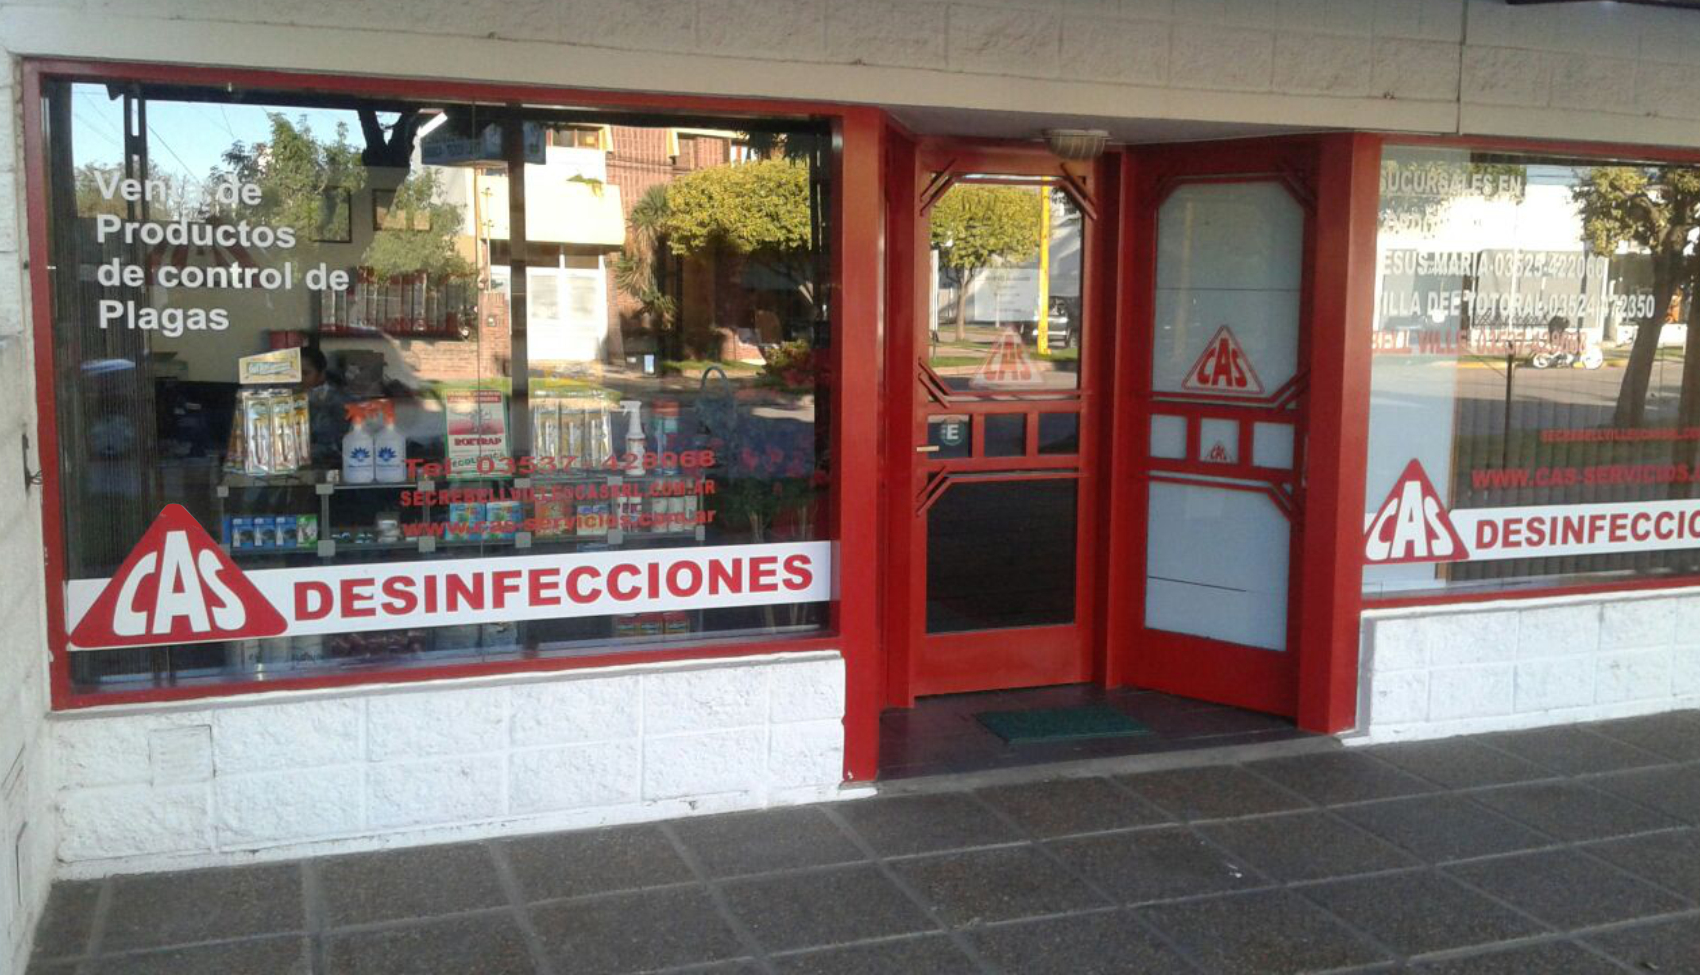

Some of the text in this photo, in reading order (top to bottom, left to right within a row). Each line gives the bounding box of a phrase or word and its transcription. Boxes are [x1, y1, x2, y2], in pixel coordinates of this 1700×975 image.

[94, 170, 262, 205] Ven de
[1498, 174, 1521, 197] EN
[97, 215, 296, 248] Productos
[98, 258, 145, 288] de
[157, 262, 292, 290] control
[305, 264, 349, 291] de
[99, 300, 230, 337] Plagas
[985, 334, 1032, 381] CAS
[1197, 337, 1247, 388] CAS
[1365, 480, 1454, 560] CAS
[112, 530, 246, 637] CAS
[294, 554, 814, 621] DESINFECCIONES
